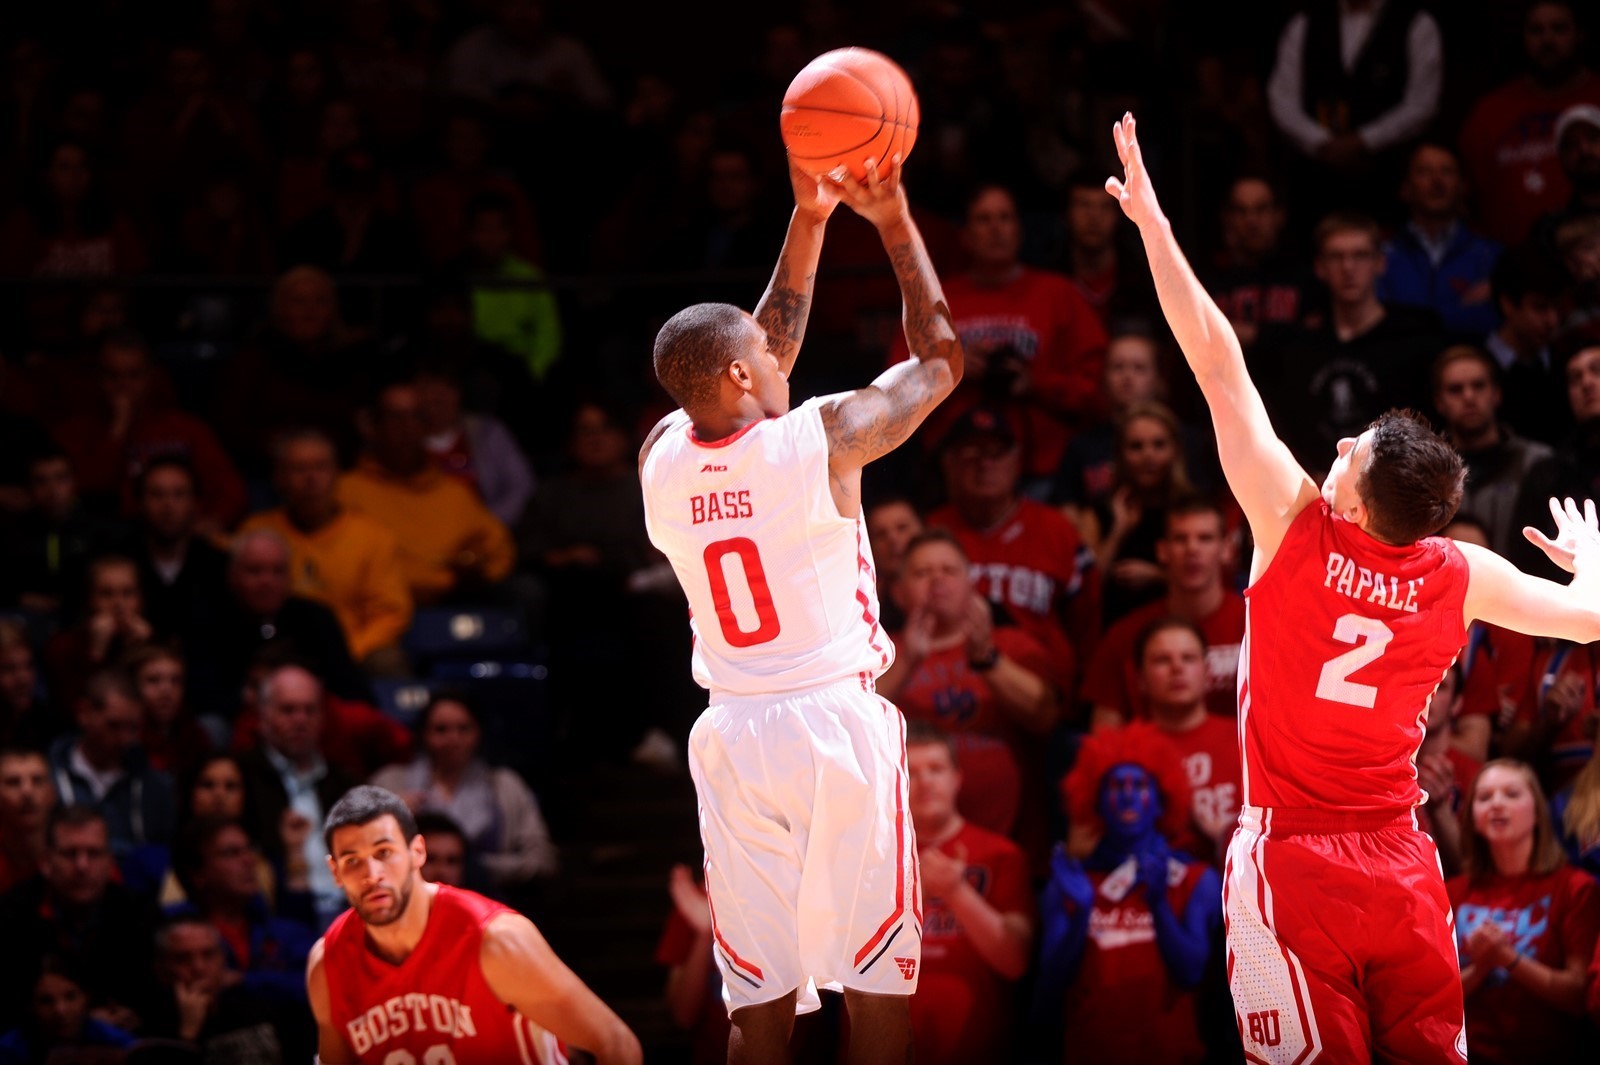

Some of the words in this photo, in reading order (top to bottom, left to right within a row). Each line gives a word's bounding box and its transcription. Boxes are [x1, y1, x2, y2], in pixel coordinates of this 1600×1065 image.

[690, 490, 753, 525] BASS
[703, 537, 781, 648] 0
[1323, 551, 1425, 613] PAPALE
[1314, 612, 1395, 710] 2
[345, 991, 478, 1056] BOSTON
[1247, 1009, 1282, 1047] BU
